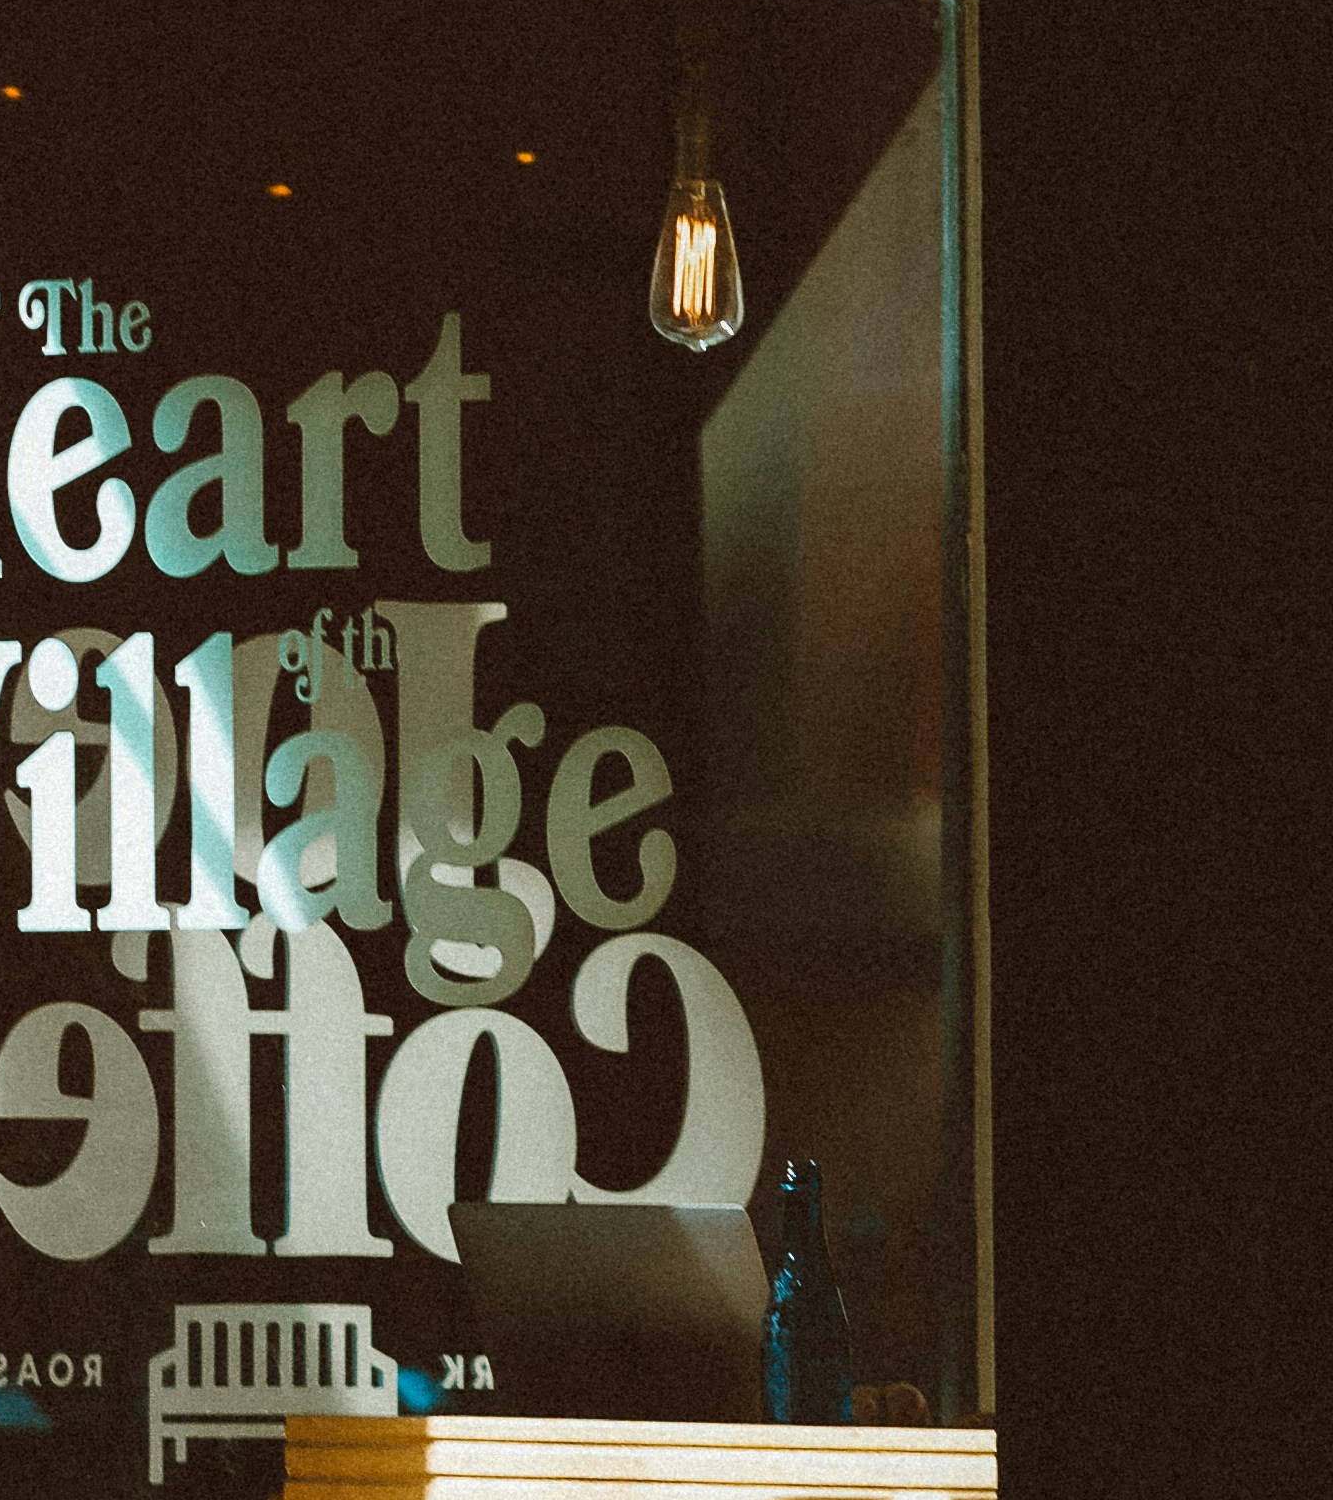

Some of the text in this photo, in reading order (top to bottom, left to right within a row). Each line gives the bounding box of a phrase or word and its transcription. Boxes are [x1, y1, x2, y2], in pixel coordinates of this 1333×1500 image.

[18, 278, 153, 356] The
[277, 606, 395, 702] of th
